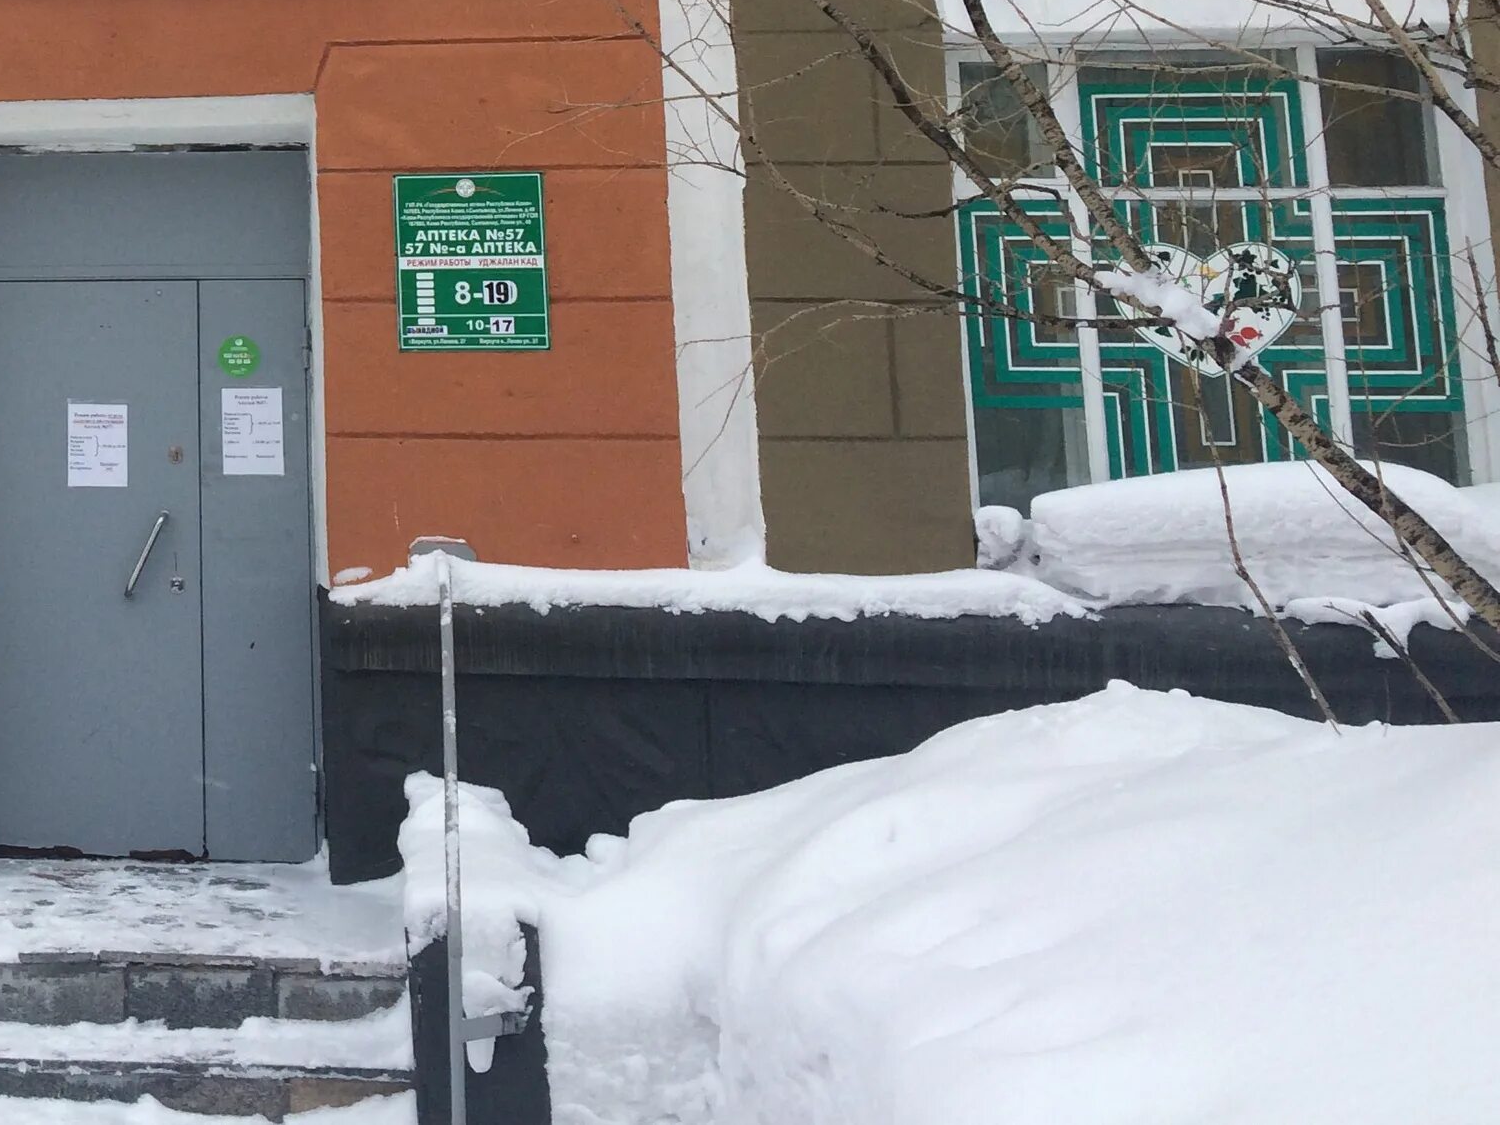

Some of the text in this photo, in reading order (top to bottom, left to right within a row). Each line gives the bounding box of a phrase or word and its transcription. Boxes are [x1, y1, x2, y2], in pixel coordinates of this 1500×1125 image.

[415, 228, 525, 241] АПТЕКА №57
[404, 241, 537, 254] 57 №-а АПТЕКА
[406, 258, 471, 267] РЕЖИМ РАБОТЫ
[478, 257, 538, 267] УДЖАЛАН КАД
[466, 319, 513, 333] 10-17
